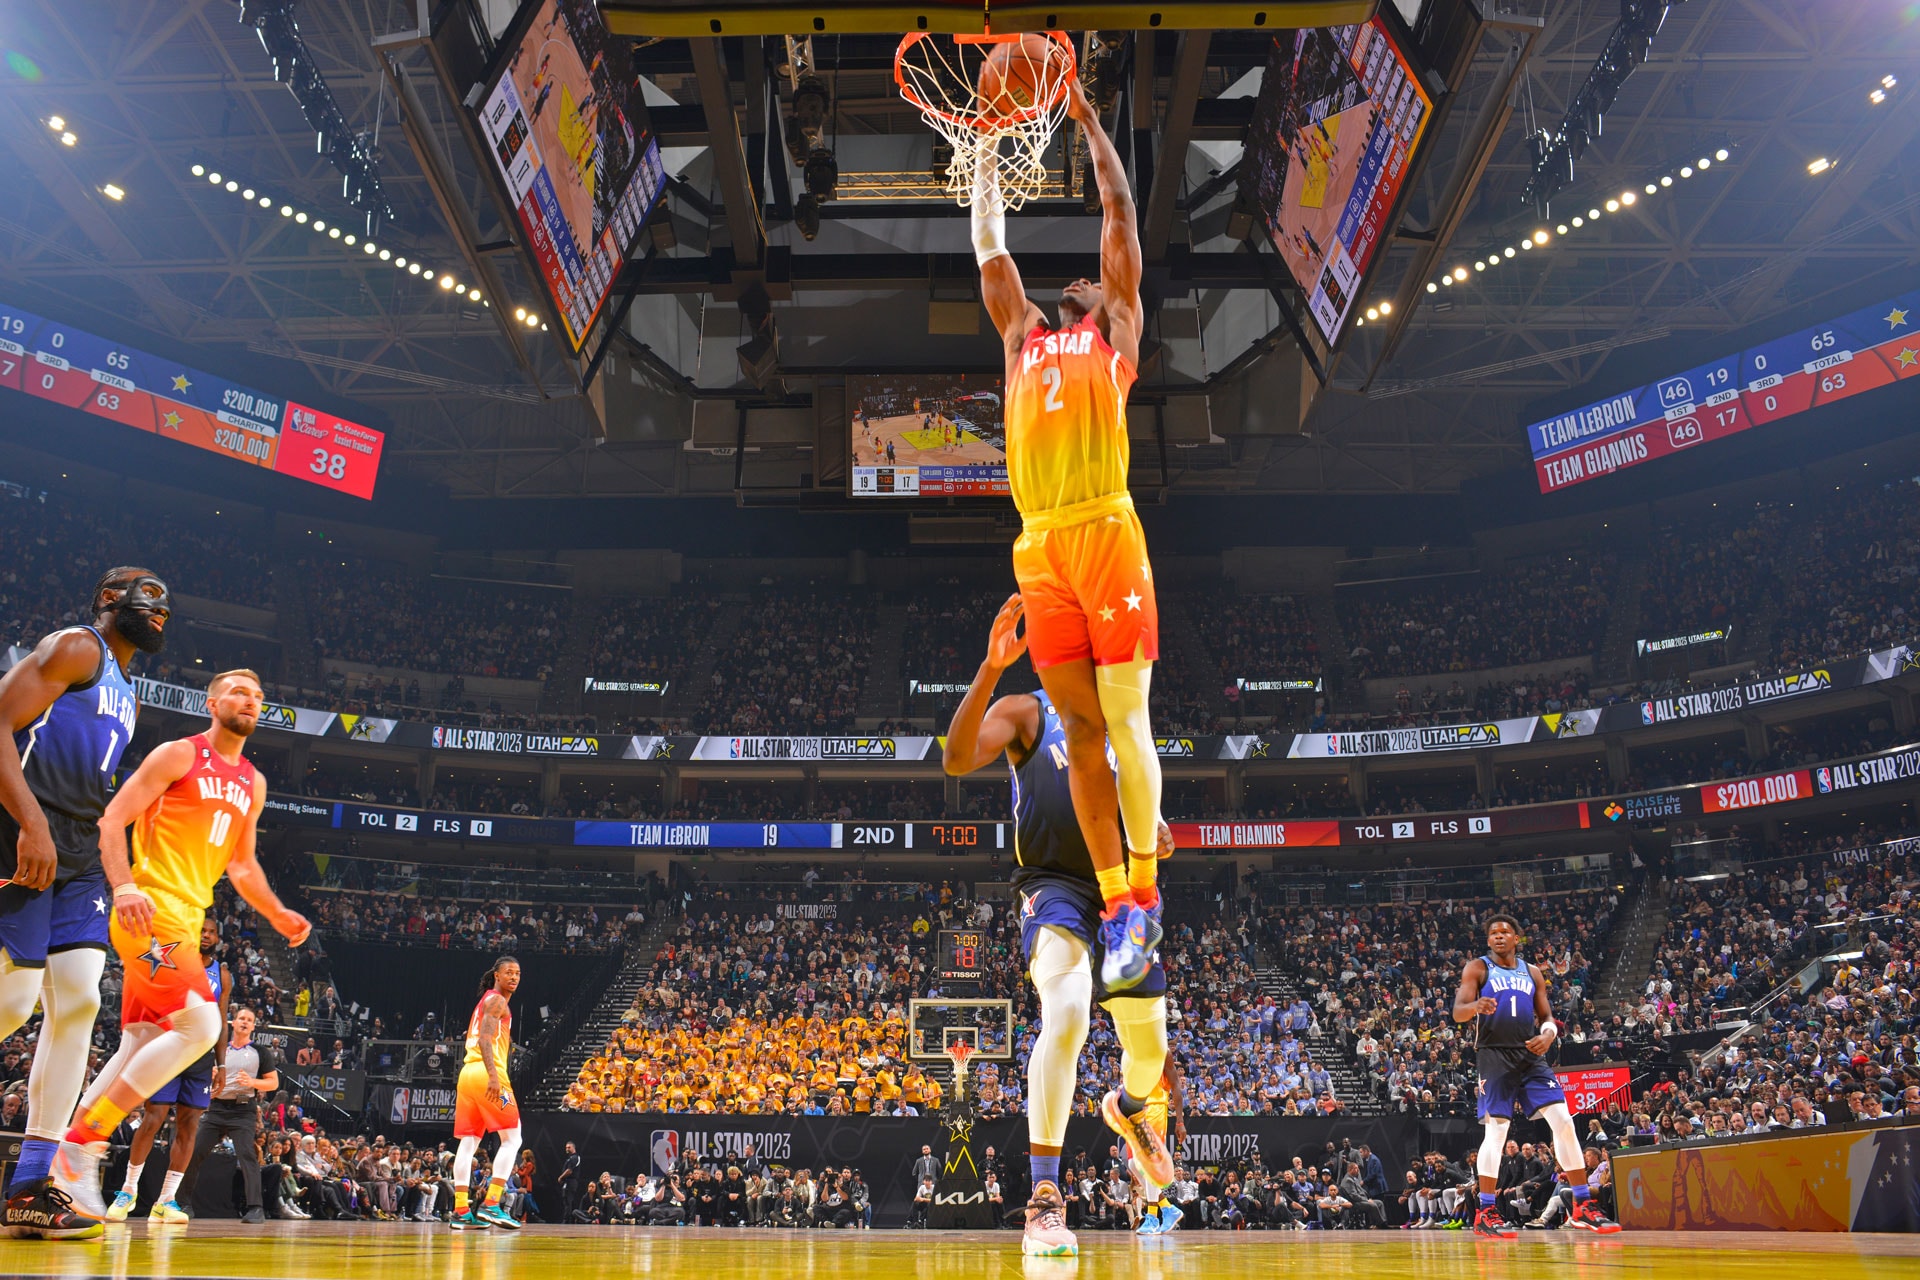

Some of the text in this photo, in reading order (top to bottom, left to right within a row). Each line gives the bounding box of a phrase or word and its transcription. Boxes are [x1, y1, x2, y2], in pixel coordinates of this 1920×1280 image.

[2, 316, 130, 371] 19 0 65
[1811, 331, 1836, 351] 65
[43, 354, 63, 367] 3RD
[1812, 353, 1844, 370] TOTAL
[2, 360, 120, 410] 7 0 63
[99, 372, 127, 389] TOTAL
[1042, 367, 1064, 413] 2
[1757, 377, 1775, 389] 3RD
[1539, 417, 1578, 449] TEAM
[1664, 383, 1687, 401] 46
[1706, 368, 1729, 387] 19
[1754, 354, 1767, 370] 0
[1713, 391, 1731, 403] 2ND
[1672, 406, 1688, 417] 1ST
[228, 415, 264, 433] CHARITY
[1544, 373, 1847, 487] TEAM GIANNIS 46 17 0 63
[310, 448, 346, 479] 38
[860, 476, 868, 488] 19
[902, 476, 910, 488] 17
[1688, 633, 1705, 643] UTAH
[955, 684, 970, 692] UTAH
[1282, 681, 1298, 689] UTAH
[1713, 687, 1743, 713] 2023
[1746, 678, 1787, 701] UTAH
[101, 729, 119, 771] 1
[496, 733, 522, 753] 2023
[526, 736, 562, 751] UTAH
[792, 738, 818, 758] 2023
[822, 739, 856, 754] UTAH
[1391, 730, 1418, 751] 2023
[1421, 729, 1459, 746] UTAH
[1897, 751, 1920, 779] 202
[1718, 773, 1798, 809] $200,000
[264, 800, 288, 812] others
[288, 803, 301, 815] Big
[1626, 794, 1681, 810] RAISE the
[1627, 804, 1682, 820] FUTURE
[208, 810, 232, 847] 10
[359, 811, 485, 834] TOL 2 FLS 0
[1355, 819, 1484, 839] TOL 2 FLS 0
[631, 825, 662, 846] TEAM
[763, 824, 778, 846] 19
[853, 827, 895, 844] 2ND
[932, 826, 977, 846] 7:00
[1199, 825, 1285, 846] TEAM GIANNIS
[819, 904, 837, 919] 2023
[953, 935, 978, 947] 7:00
[956, 948, 975, 968] 18
[951, 971, 982, 979] TISSOT
[1510, 996, 1517, 1017] 1
[1574, 1092, 1596, 1110] 38
[412, 1108, 439, 1120] UTAH
[755, 1132, 791, 1160] 2023
[1223, 1134, 1258, 1160] 2023
[1628, 1168, 1644, 1210] G
